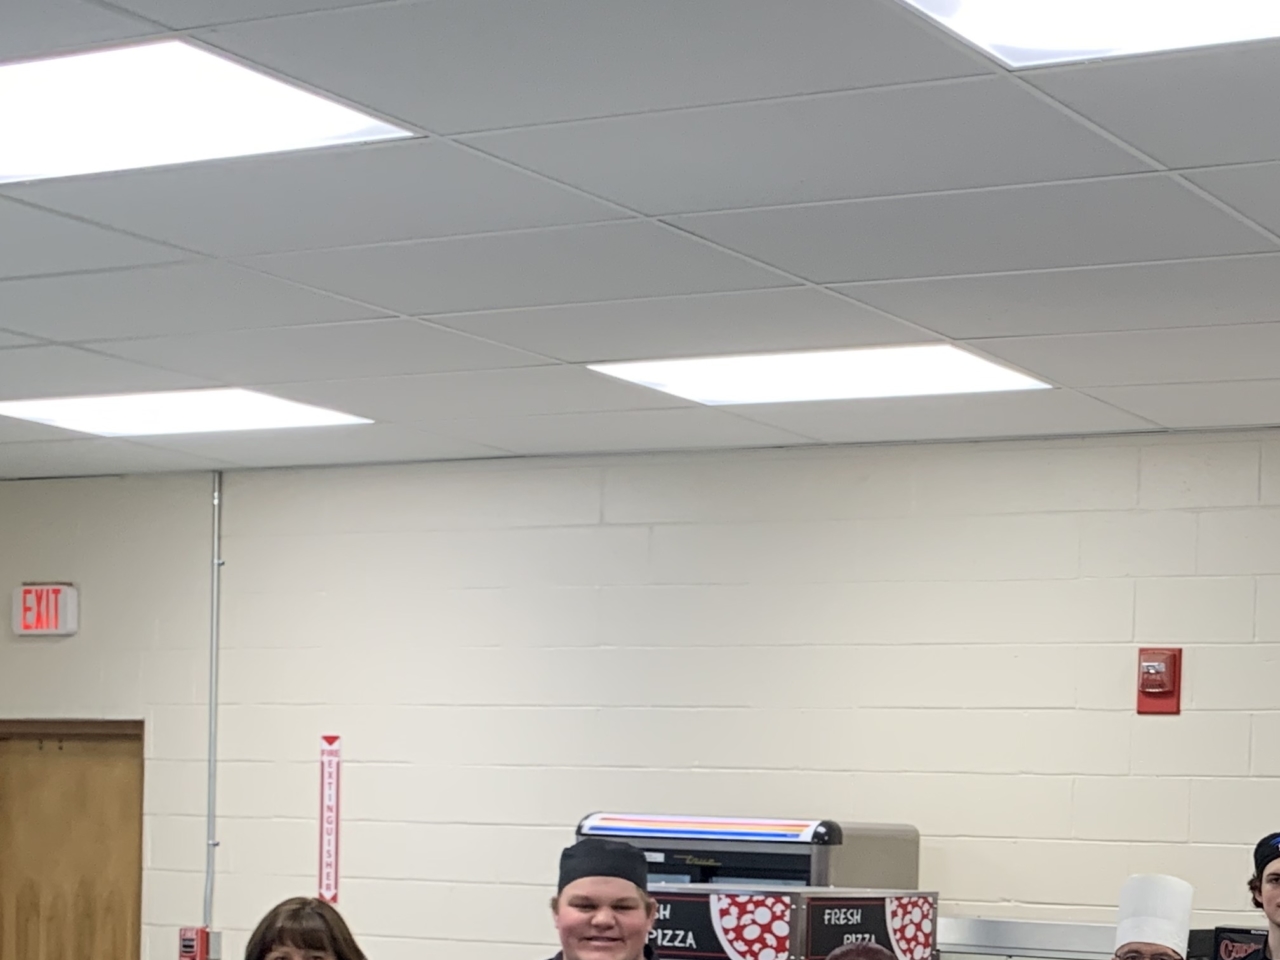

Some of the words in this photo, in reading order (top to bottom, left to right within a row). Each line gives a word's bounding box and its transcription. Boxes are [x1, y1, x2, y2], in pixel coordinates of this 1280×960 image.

[22, 588, 61, 630] EXIT
[320, 749, 340, 757] FIRE
[325, 759, 334, 892] EXTINGUISHER
[823, 908, 862, 925] FRESH
[645, 928, 697, 949] PIZZA
